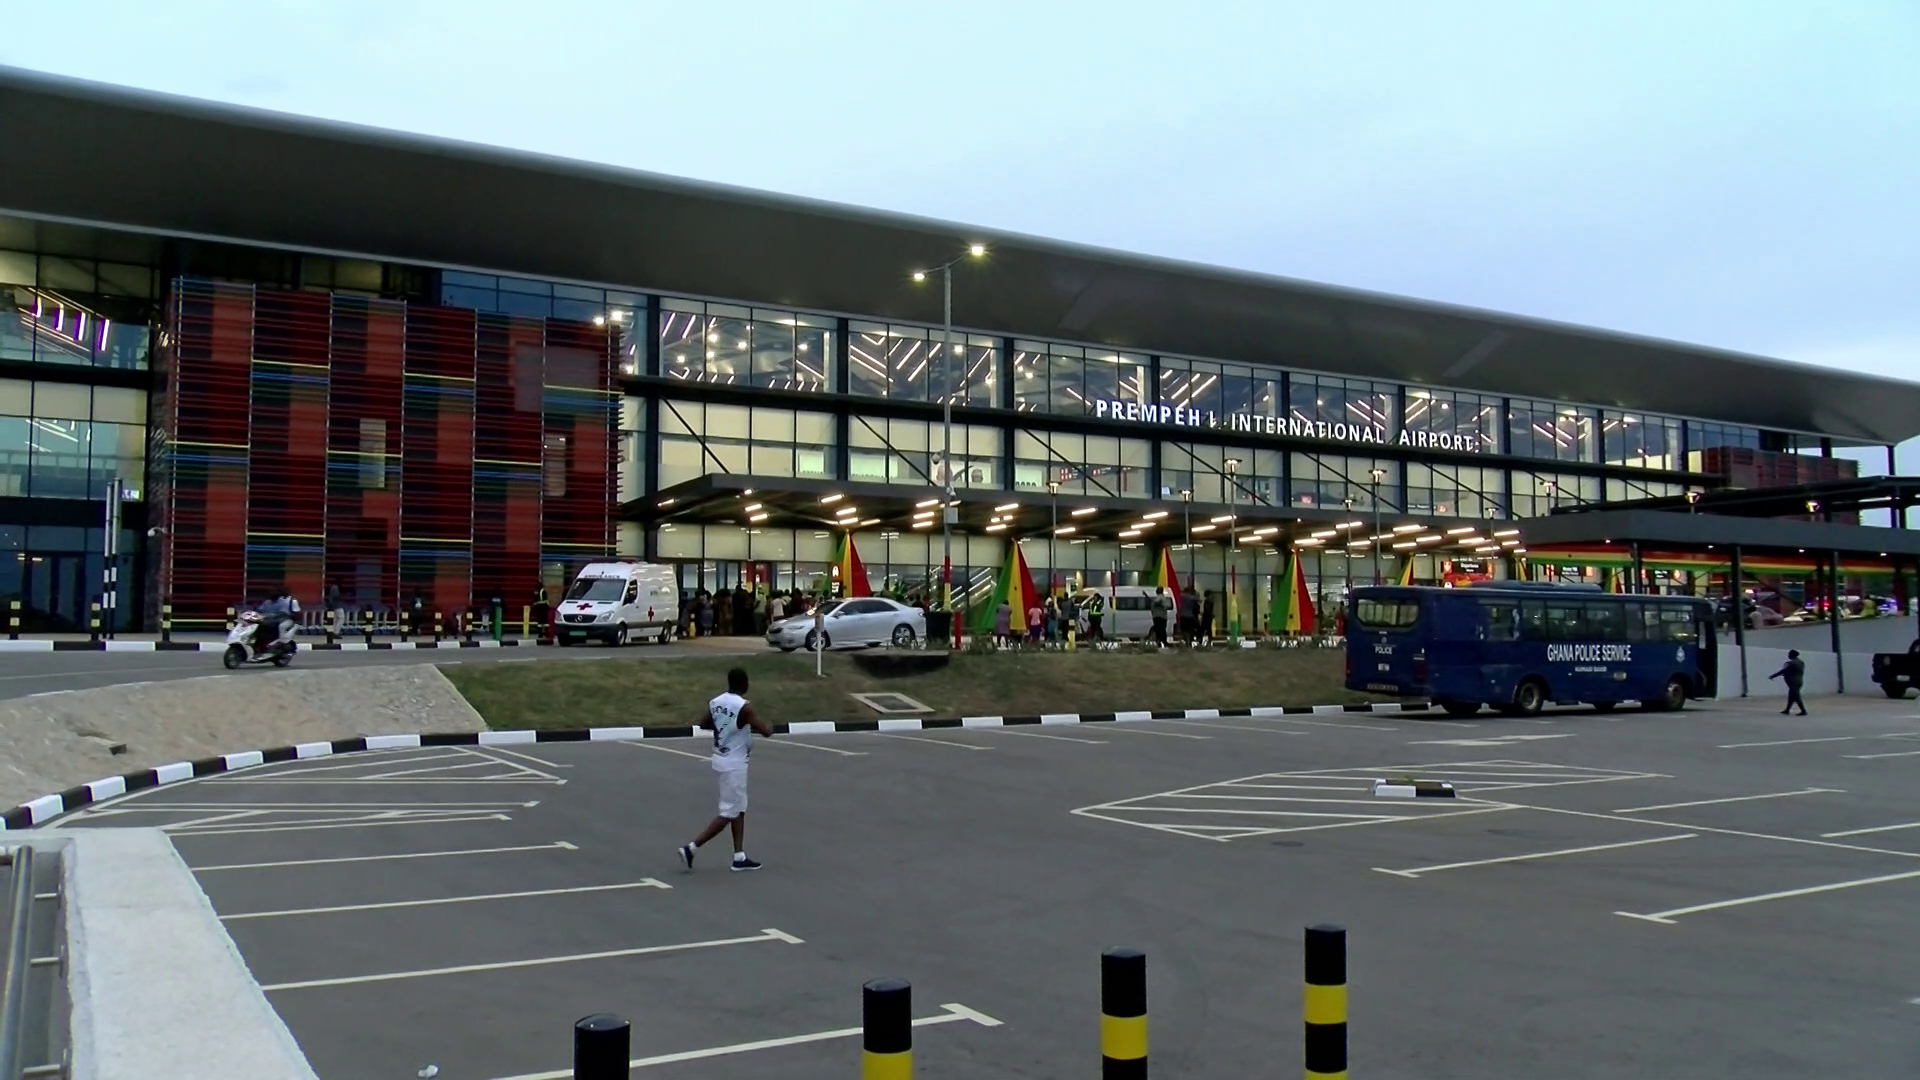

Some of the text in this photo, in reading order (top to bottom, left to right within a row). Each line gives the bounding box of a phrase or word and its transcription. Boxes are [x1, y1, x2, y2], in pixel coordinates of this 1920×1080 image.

[1096, 399, 1200, 427] PREMPEH
[1231, 413, 1385, 444] INTERNATIONAL
[1399, 429, 1473, 451] AIRPORT
[1374, 645, 1393, 655] POLICE
[1547, 644, 1632, 662] GHANA POLICE SERVICE
